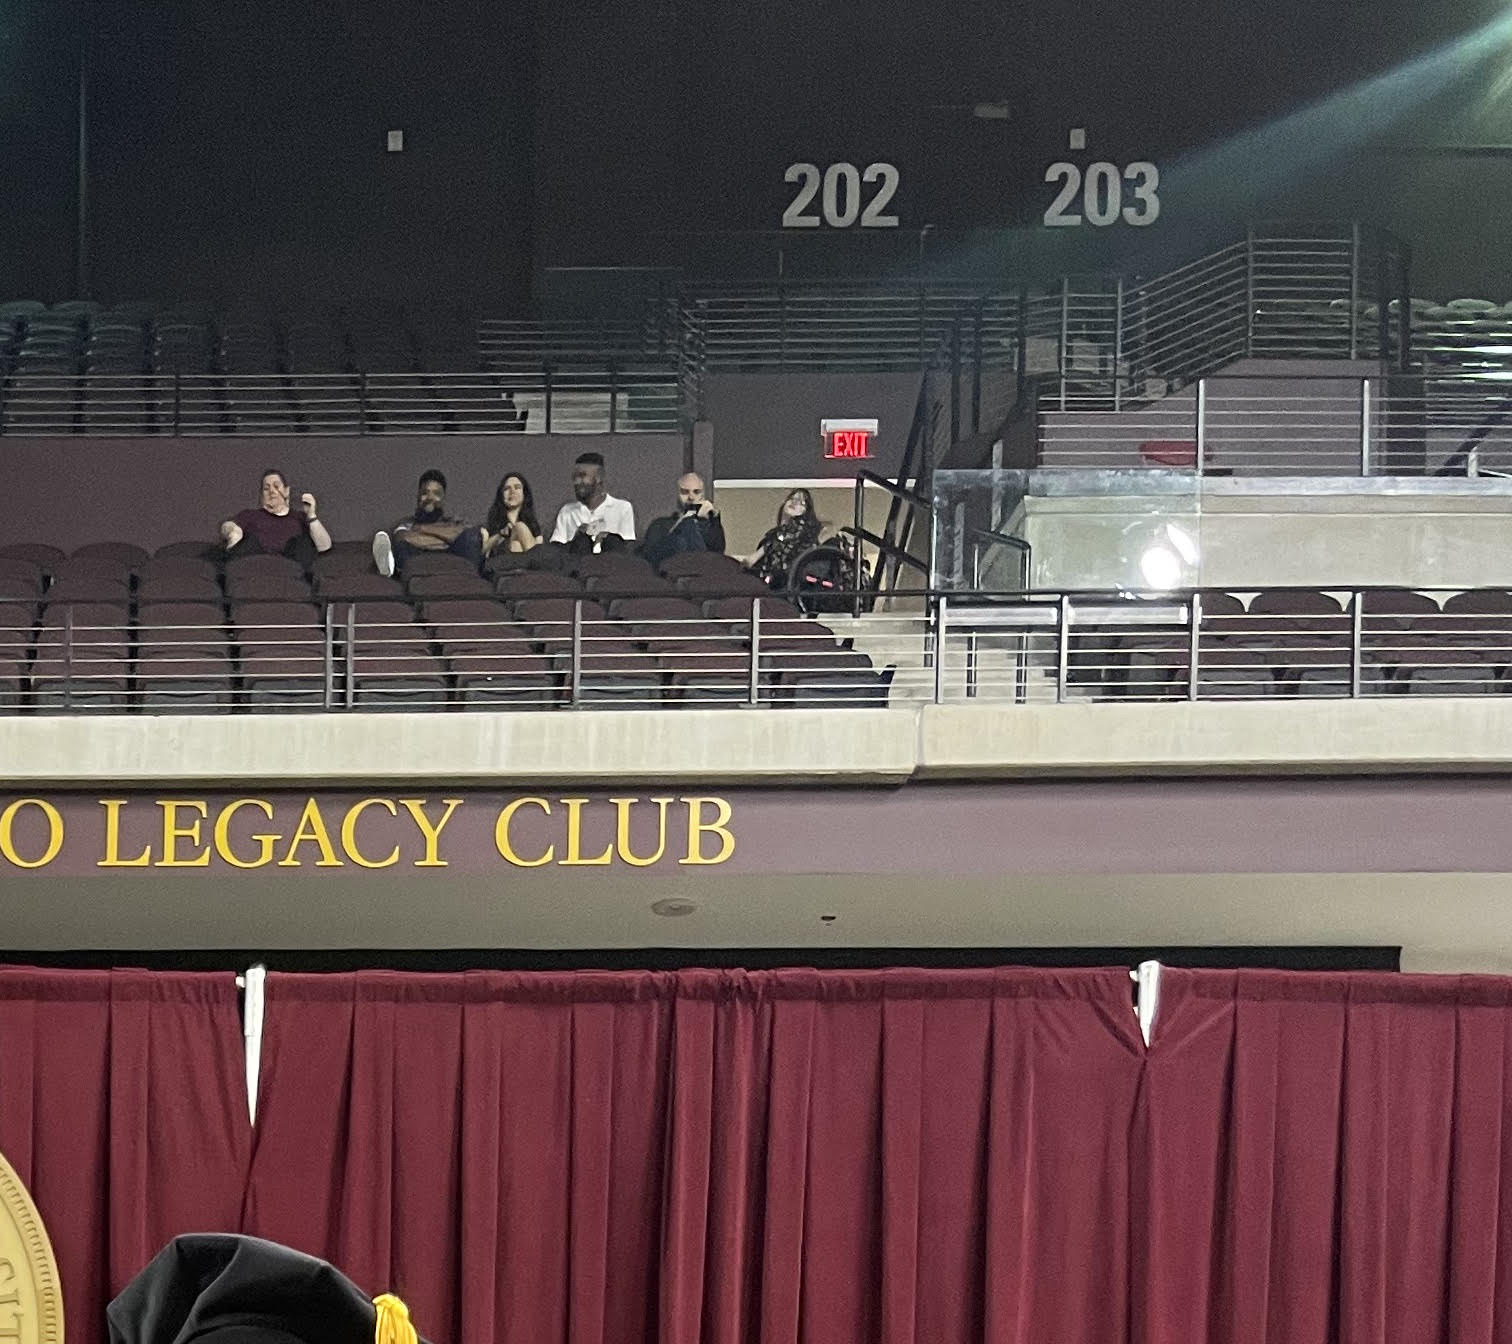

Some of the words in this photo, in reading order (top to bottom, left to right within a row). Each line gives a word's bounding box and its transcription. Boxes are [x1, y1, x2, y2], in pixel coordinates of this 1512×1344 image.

[782, 162, 900, 227] 202
[1043, 161, 1160, 226] 203
[833, 432, 869, 456] EXIT
[96, 797, 464, 868] LEGACY
[494, 797, 736, 867] CLUB
